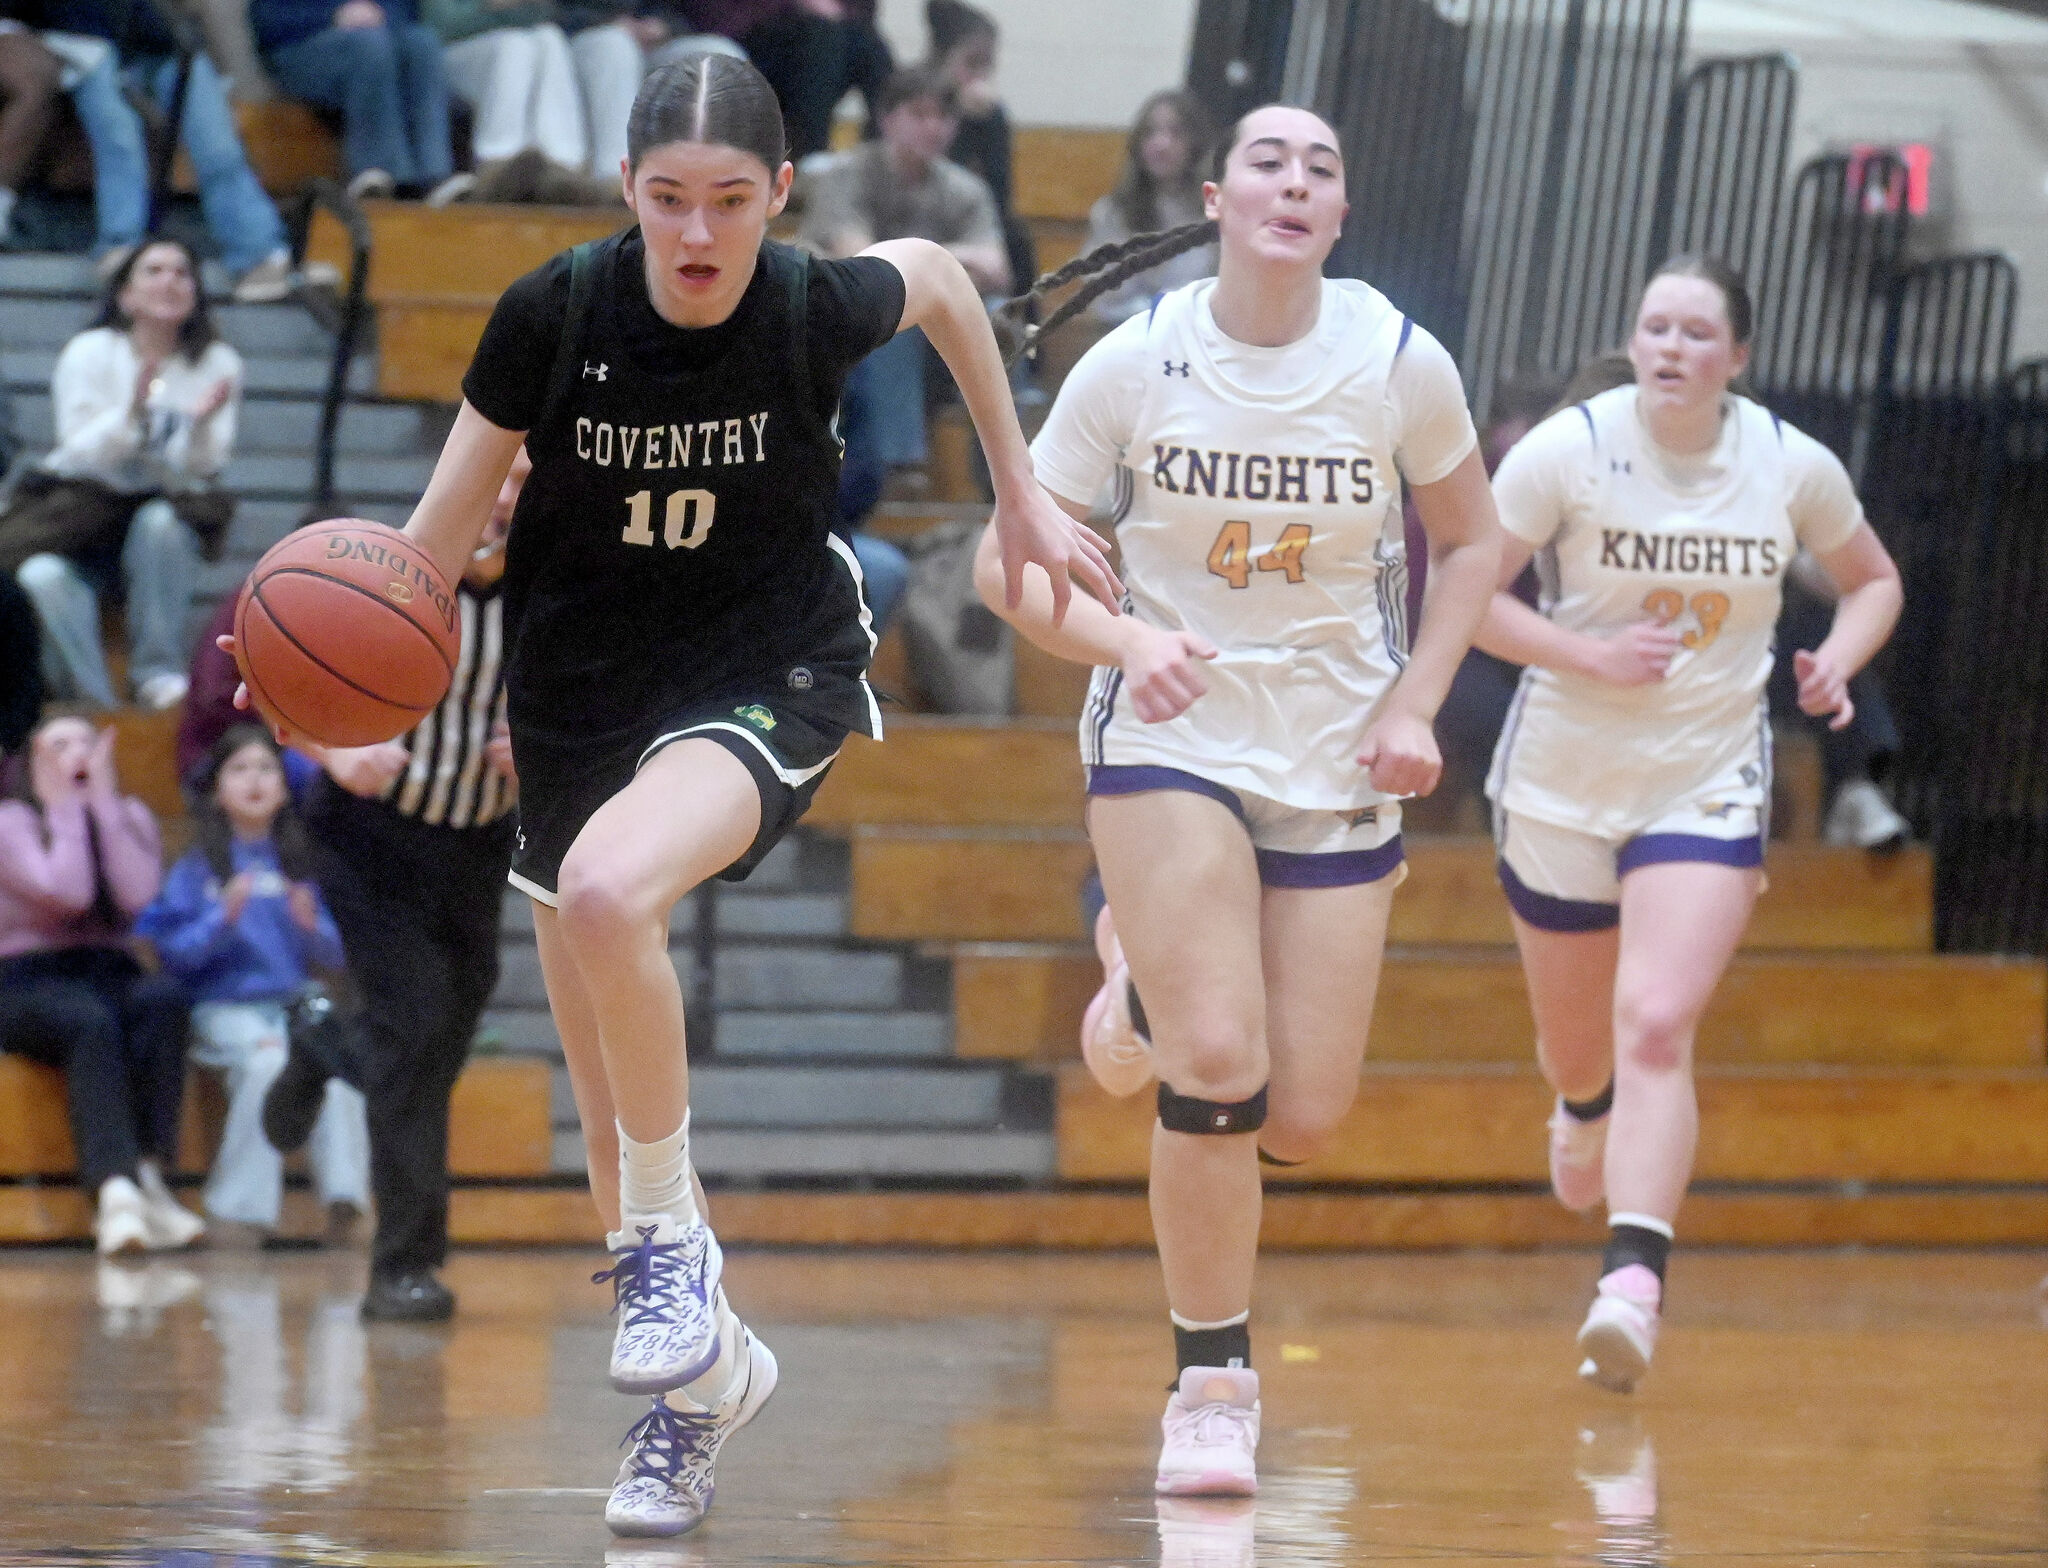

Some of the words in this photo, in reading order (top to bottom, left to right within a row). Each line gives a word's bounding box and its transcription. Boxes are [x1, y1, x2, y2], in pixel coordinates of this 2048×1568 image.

[576, 411, 768, 469] COVENTRY
[1153, 445, 1374, 504] KNIGHTS
[622, 488, 716, 550] 10
[1206, 520, 1313, 589] 44
[1600, 528, 1779, 577] KNIGHTS
